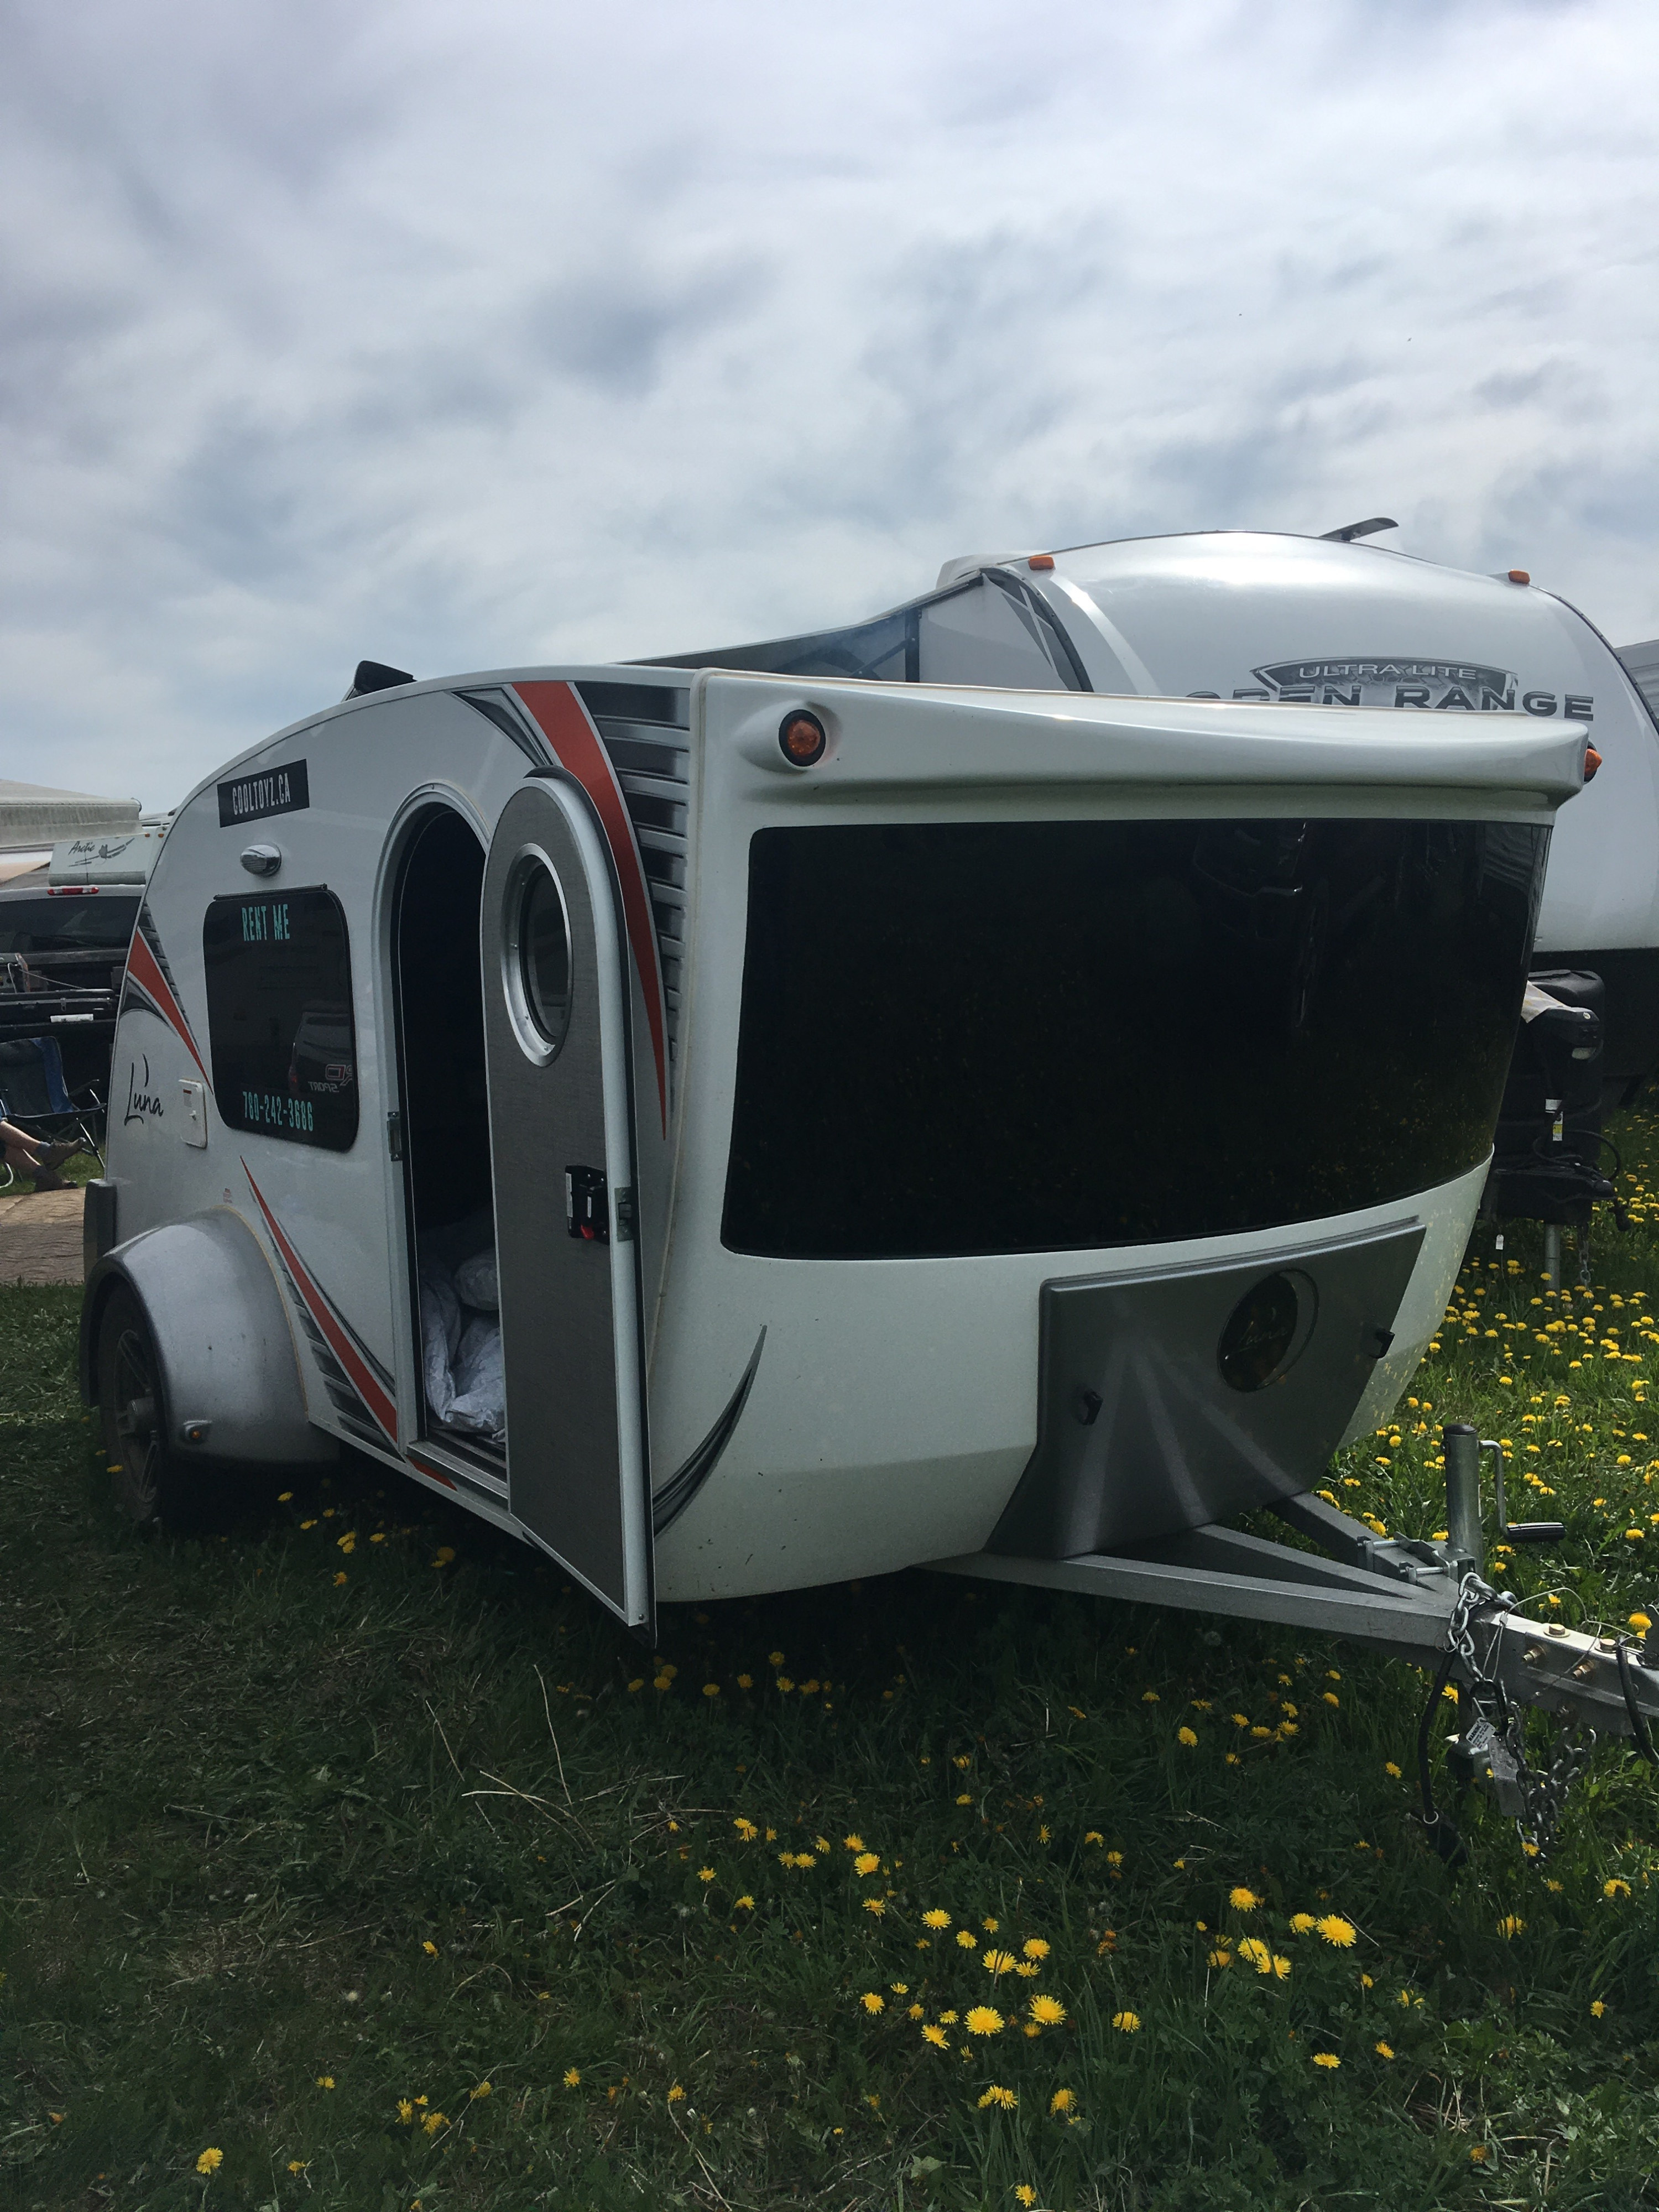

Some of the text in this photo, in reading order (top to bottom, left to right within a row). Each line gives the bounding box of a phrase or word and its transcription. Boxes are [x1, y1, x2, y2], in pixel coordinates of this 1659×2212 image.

[1300, 664, 1477, 680] ULTRA LITE
[1185, 685, 1594, 721] PEN RANGE
[232, 773, 290, 816] COOLTOYZ.CA
[67, 840, 95, 855] Arctic
[241, 903, 290, 941] RENT ME
[124, 1060, 164, 1126] Luna
[242, 1091, 314, 1132] 780-242-3686
